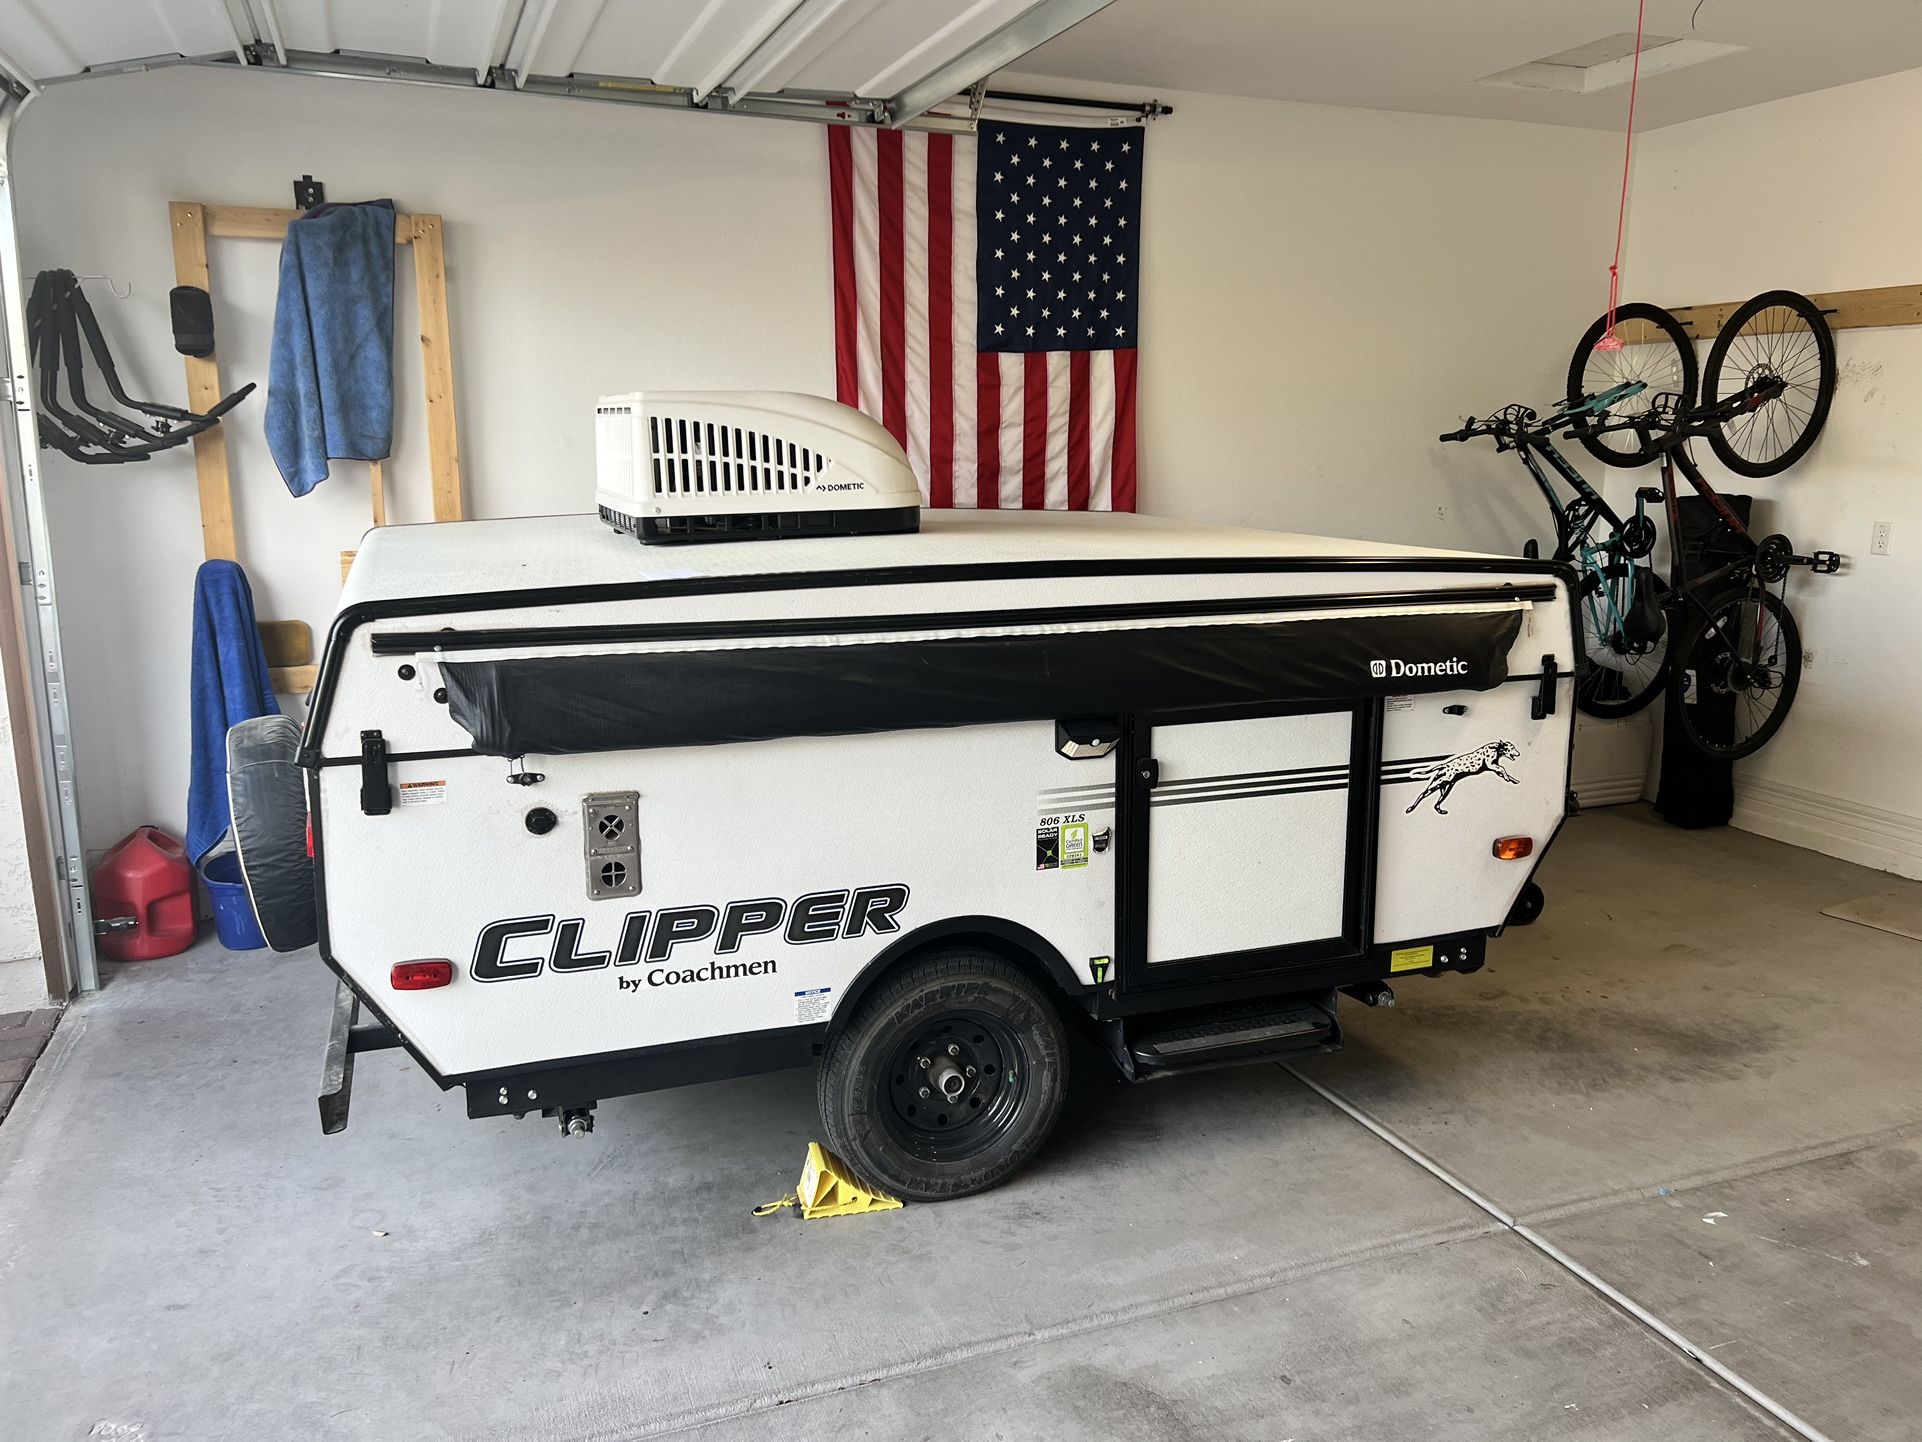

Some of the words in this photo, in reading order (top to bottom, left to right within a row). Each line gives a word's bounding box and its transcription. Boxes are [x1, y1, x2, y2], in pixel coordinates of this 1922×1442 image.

[828, 483, 865, 492] DOMETIC
[1389, 656, 1468, 678] Dometic
[1040, 817, 1060, 826] 806
[1063, 814, 1086, 824] XLS
[470, 883, 911, 984] CLIPPER
[617, 976, 642, 993] by
[647, 959, 778, 987] Coachmen
